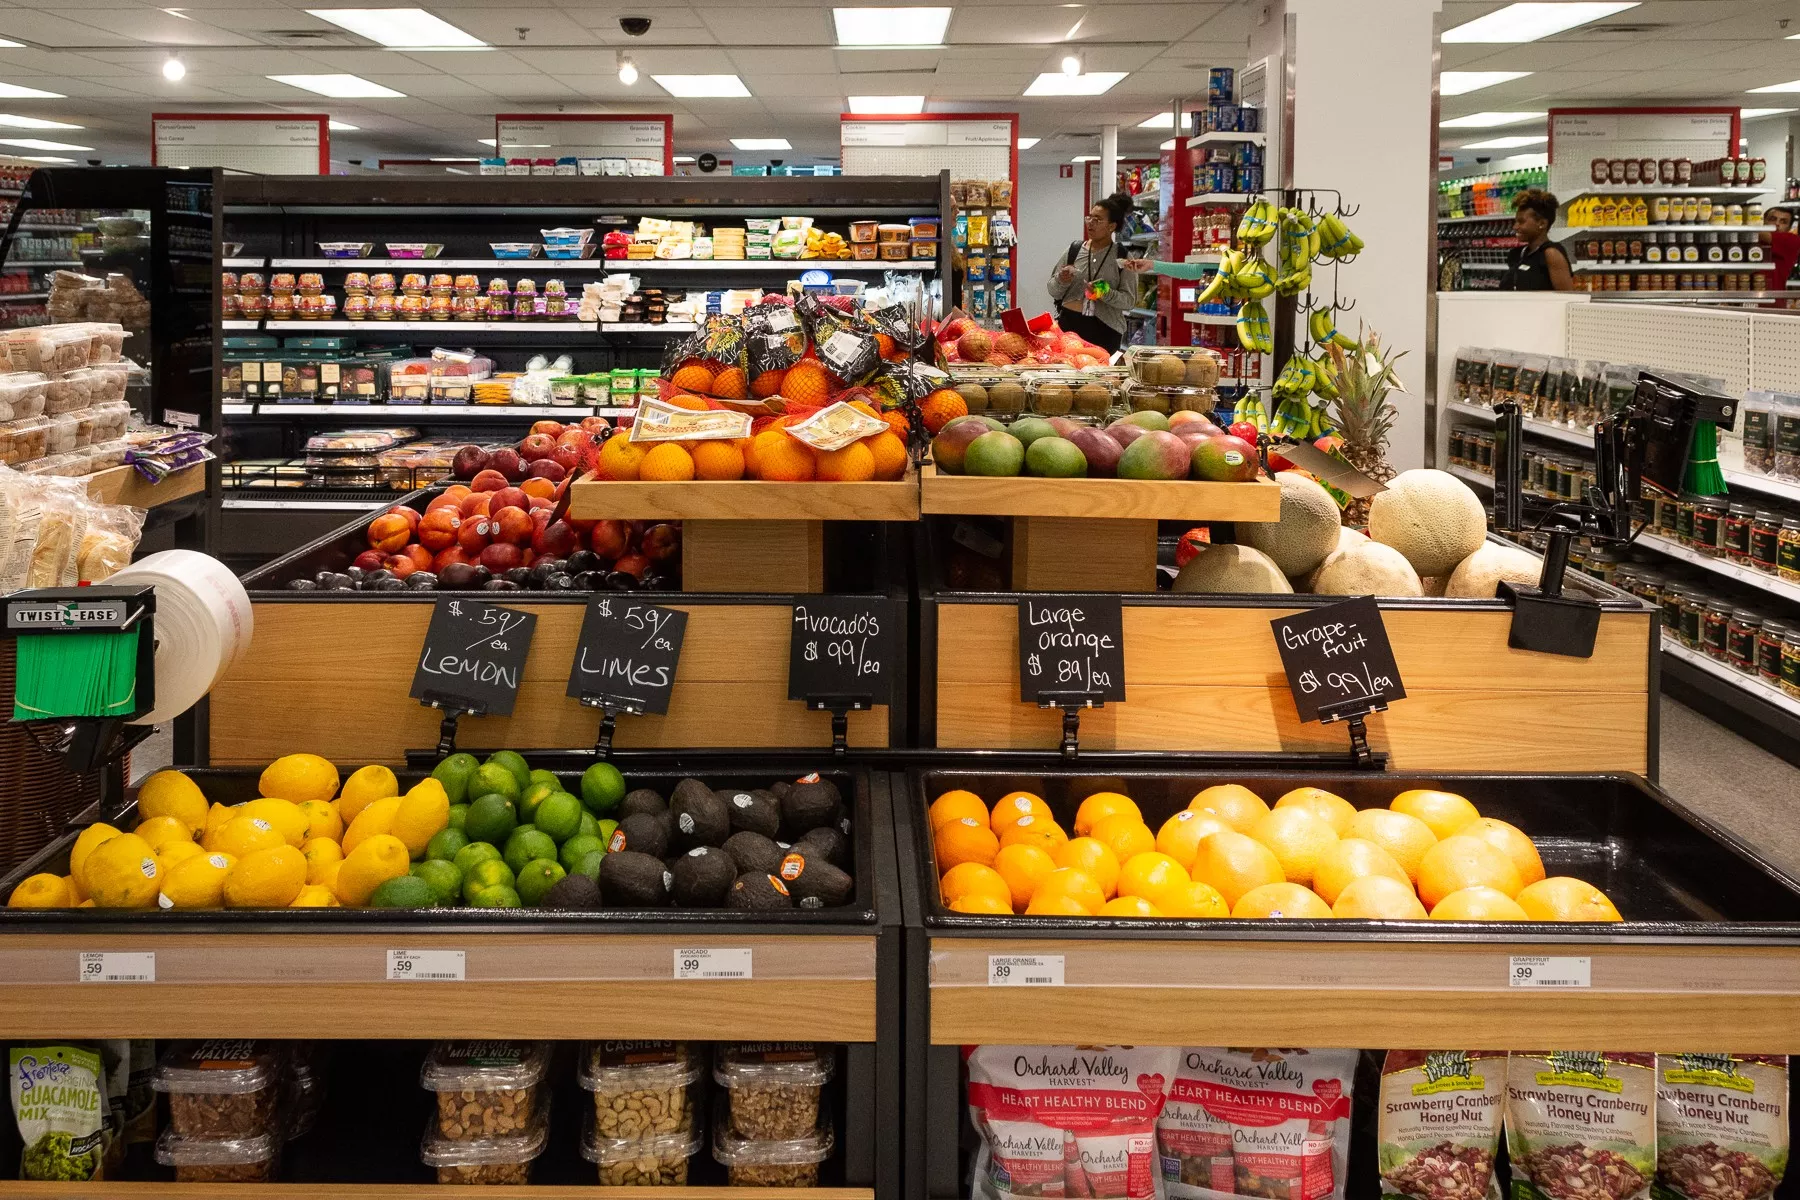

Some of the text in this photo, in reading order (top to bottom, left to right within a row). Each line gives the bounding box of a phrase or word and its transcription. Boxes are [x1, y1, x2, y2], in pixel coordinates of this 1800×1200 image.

[993, 124, 1008, 133] Chips
[501, 136, 517, 144] Candy
[20, 611, 61, 621] TWIST
[1029, 602, 1085, 633] Large
[1322, 633, 1368, 658] fruit
[83, 963, 102, 974] .59
[393, 961, 412, 971] .59
[680, 959, 699, 970] .99
[993, 966, 1011, 977] .89
[1512, 967, 1533, 978] .99
[202, 1040, 257, 1050] PECAN
[605, 1040, 673, 1053] CASHEWS
[741, 1043, 772, 1053] HALVES
[784, 1042, 814, 1051] PIECES
[191, 1049, 253, 1060] HALVES
[449, 1049, 522, 1058] MIXED NUTS
[1014, 1055, 1128, 1084] Orchard Valley
[1186, 1053, 1304, 1089] Orchard Valley
[20, 1085, 100, 1111] GUACAMOLE
[1001, 1093, 1148, 1111] HEART HEALTHY BLEND
[1171, 1085, 1211, 1099] HEART
[1215, 1091, 1274, 1107] HEALTHY
[1279, 1098, 1323, 1114] BLEND
[1508, 1088, 1649, 1117] Strawberry Cranberry
[1657, 1089, 1781, 1117] awberry Cranberry
[1386, 1099, 1454, 1115] Strawberry
[18, 1108, 49, 1122] MIX
[1420, 1109, 1483, 1124] Honey Nut
[1547, 1105, 1615, 1124] Honey Nut
[1725, 1109, 1750, 1125] Nut
[1234, 1129, 1280, 1145] Orchard
